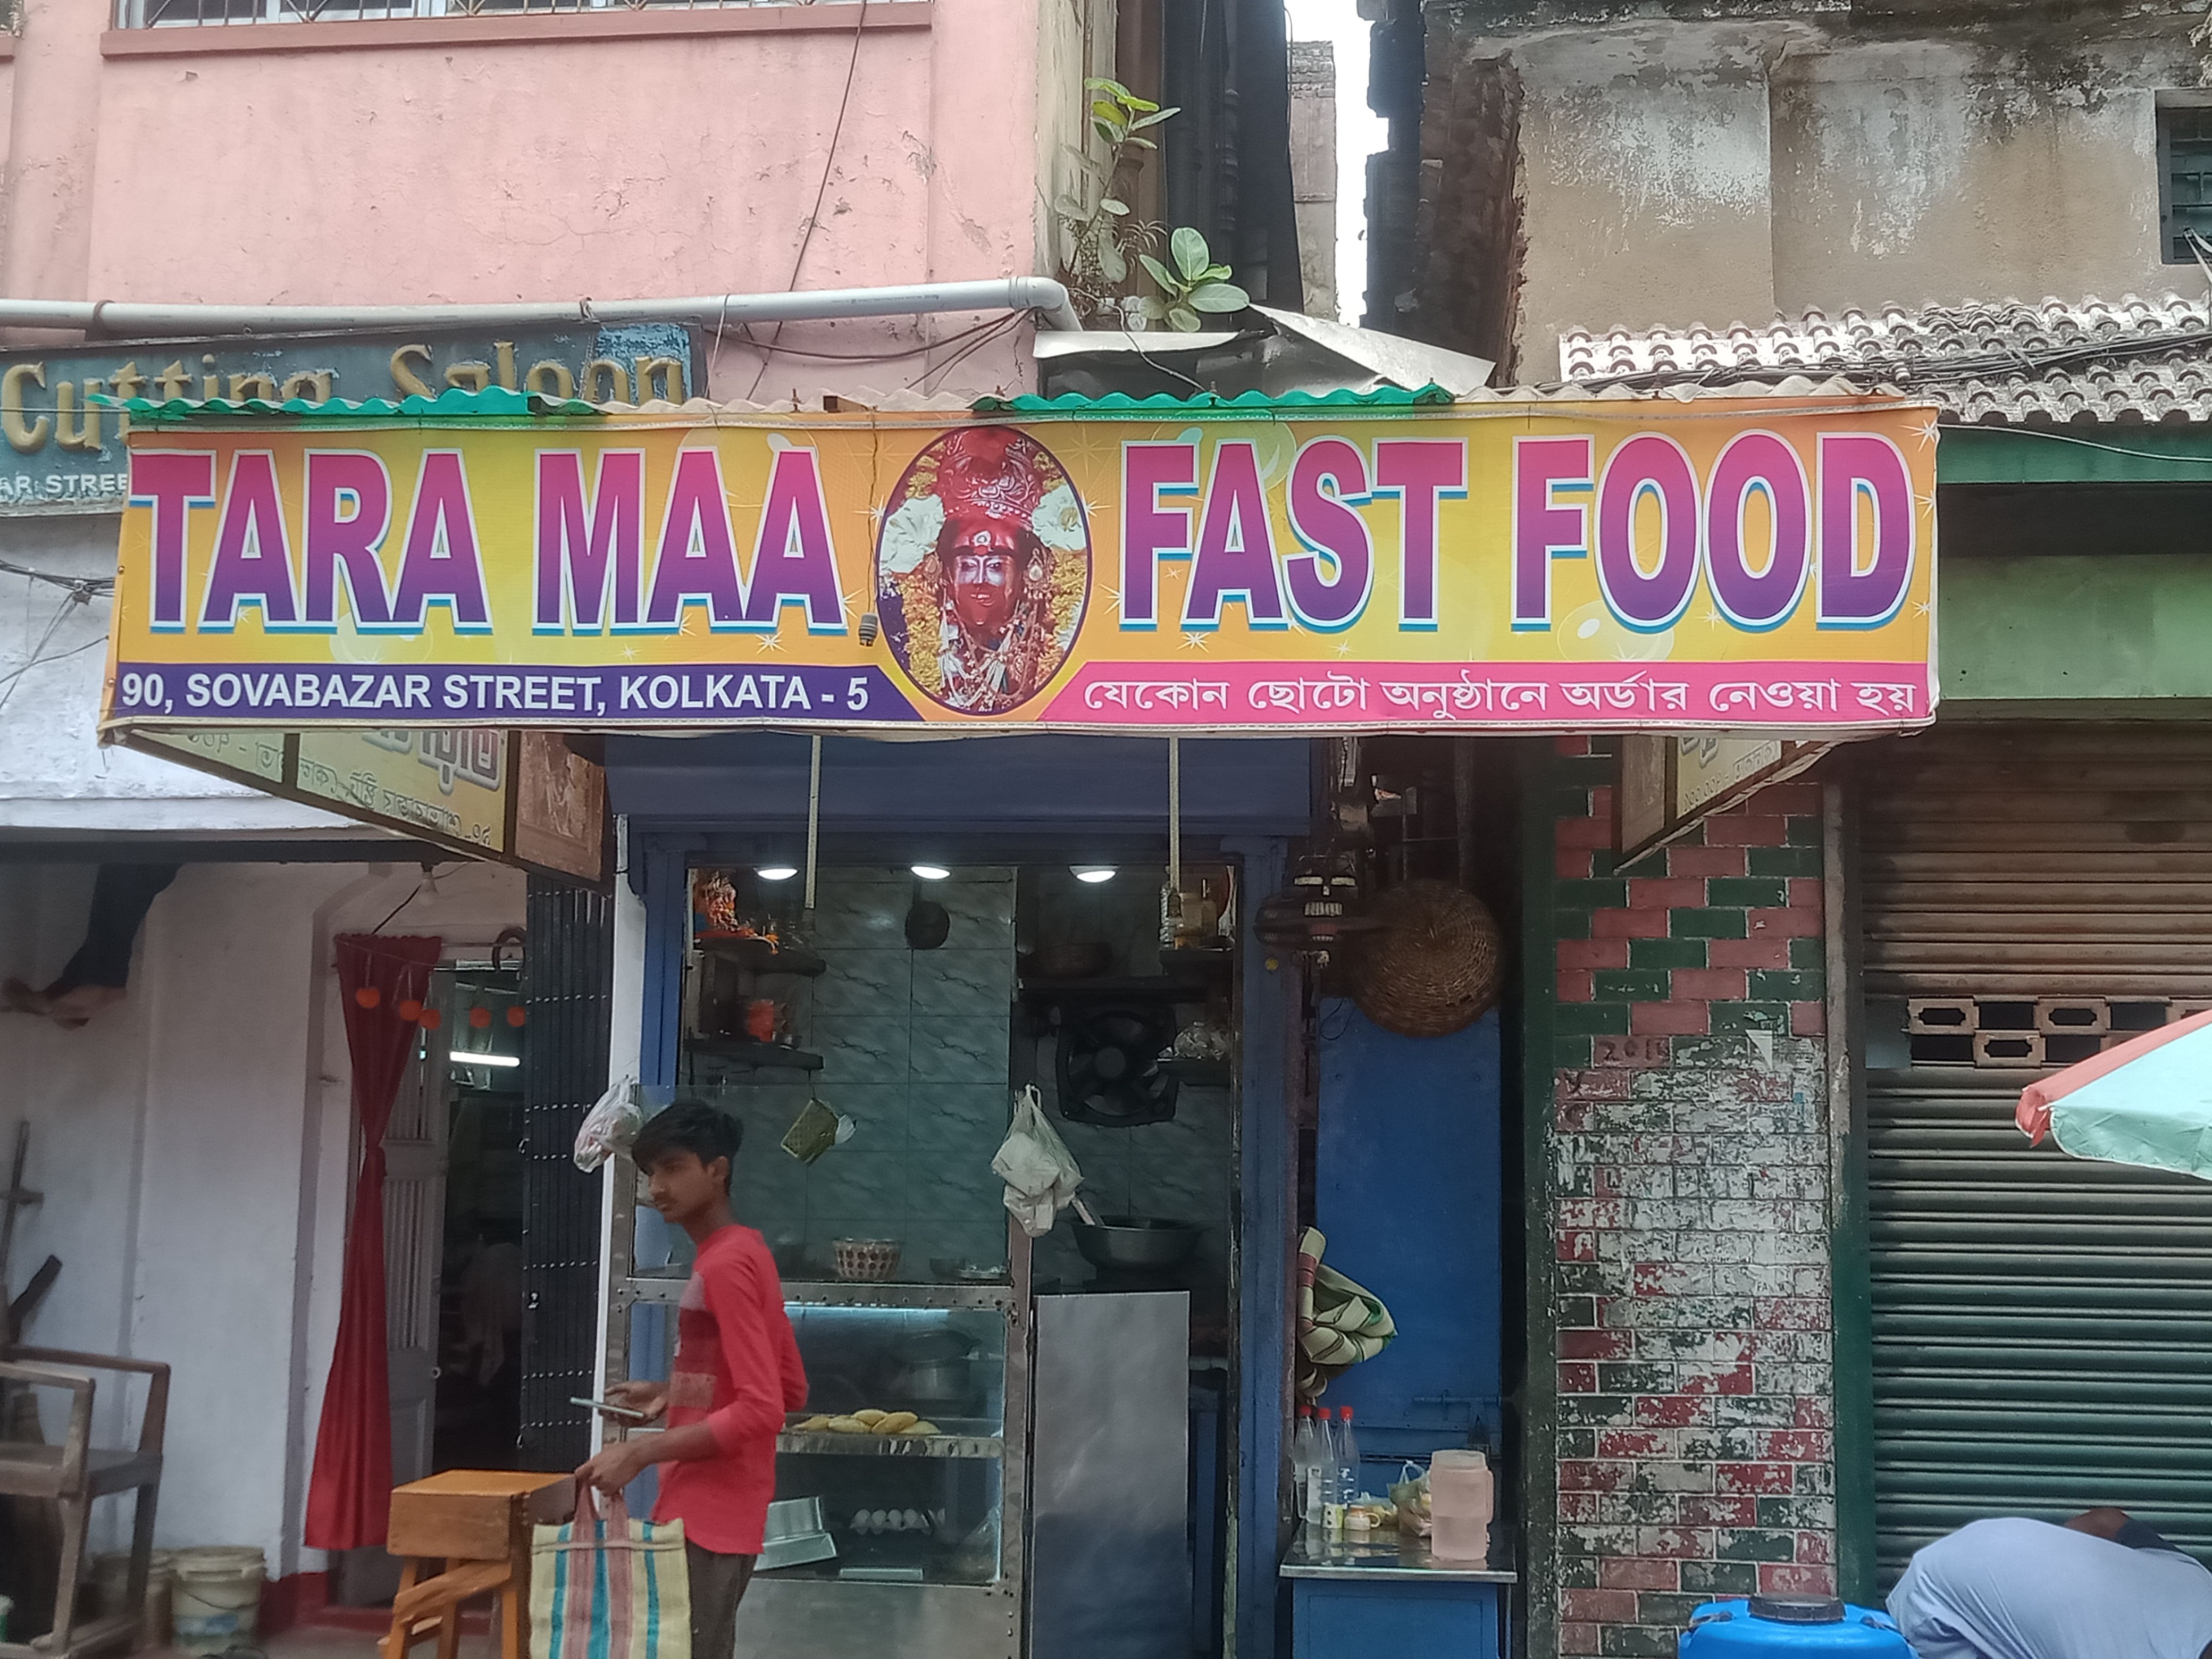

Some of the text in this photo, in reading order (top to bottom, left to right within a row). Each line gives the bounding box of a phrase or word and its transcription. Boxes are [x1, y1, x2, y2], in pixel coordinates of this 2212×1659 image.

[128, 429, 1915, 636] TARA MAA FAST FOOD
[122, 673, 173, 714] 90,
[186, 673, 432, 708] SOVABAZAR
[442, 674, 606, 716] STREET,
[620, 674, 811, 710] KOLKATA
[847, 677, 868, 710] 5
[1084, 668, 1916, 720] যেকোন ছোটো অনুষ্ঠানে অর্ডার নেওয়া হয়
